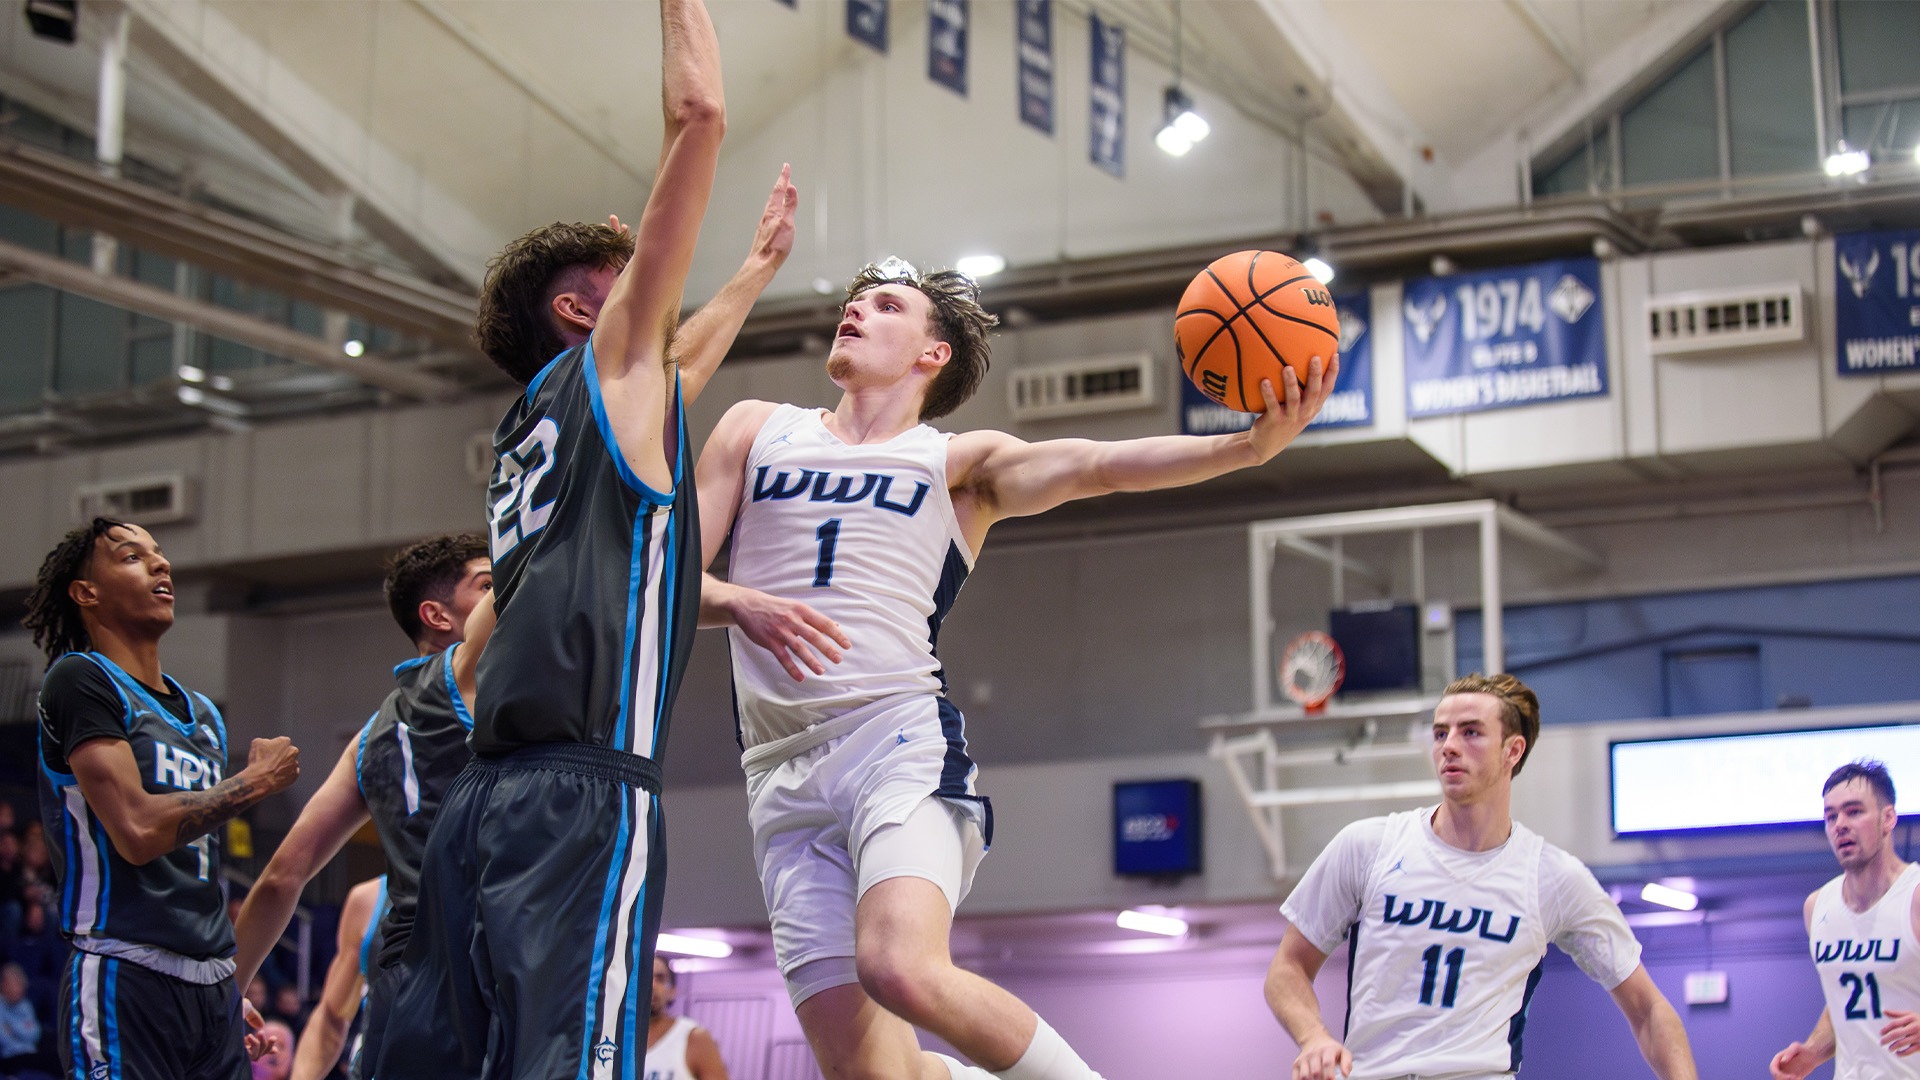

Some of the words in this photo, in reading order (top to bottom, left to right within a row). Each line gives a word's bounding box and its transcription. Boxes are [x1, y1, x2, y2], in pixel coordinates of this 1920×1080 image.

[1457, 276, 1546, 341] 1974
[1411, 372, 1495, 411] WOMEN'S
[491, 416, 561, 566] 22
[752, 465, 932, 519] WWU
[812, 517, 843, 588] 1
[154, 740, 222, 791] HPU
[1383, 894, 1521, 944] WWU
[1418, 943, 1466, 1009] 11
[1815, 938, 1901, 964] WWU
[1839, 971, 1882, 1020] 21
